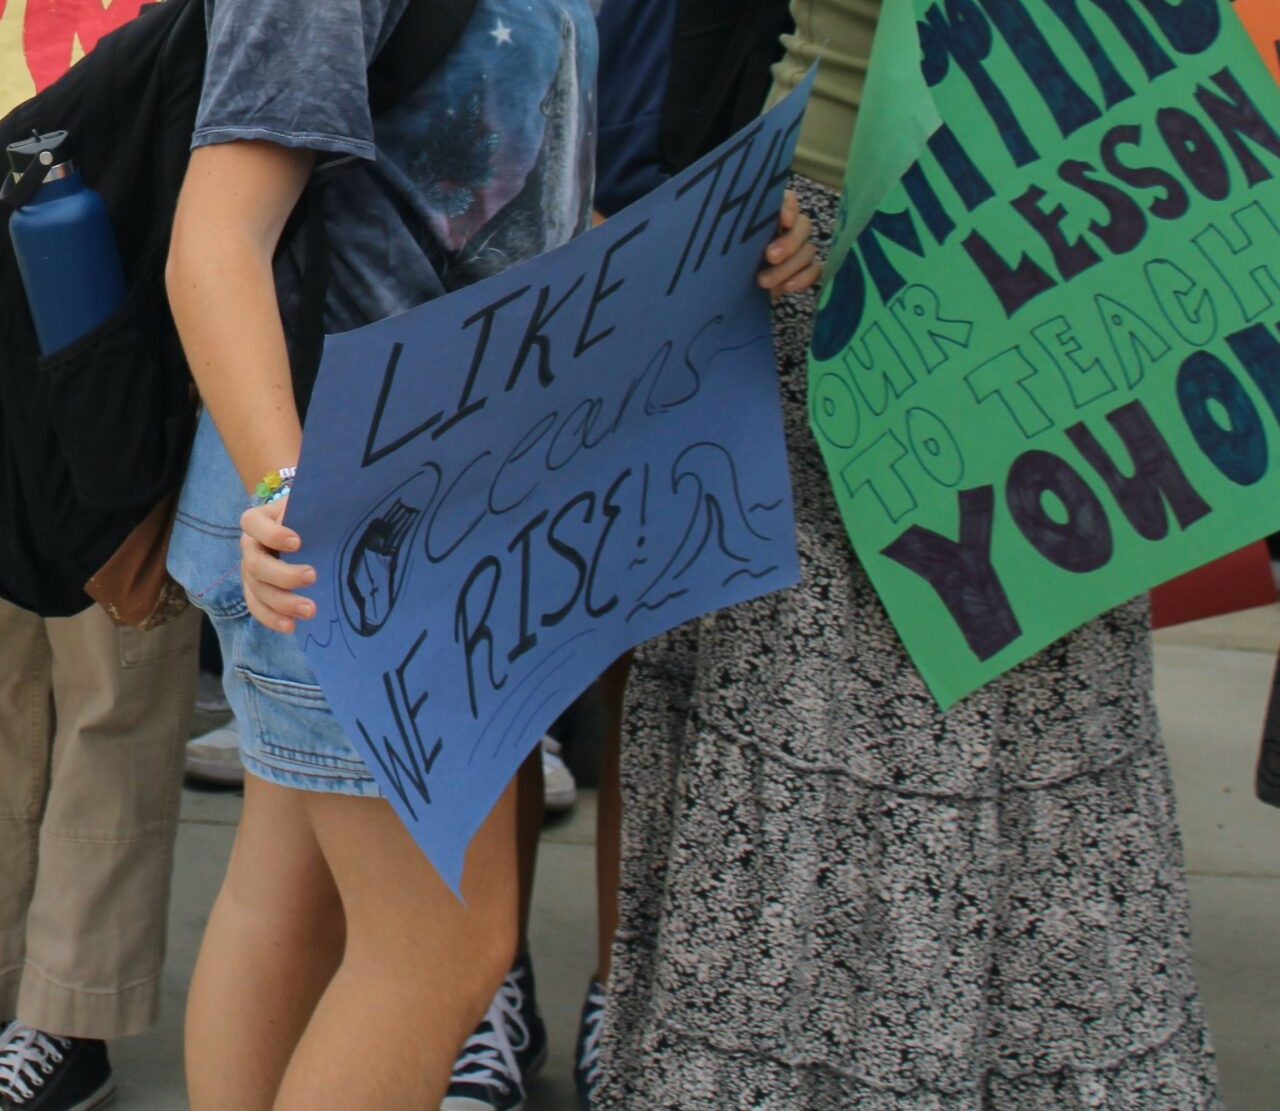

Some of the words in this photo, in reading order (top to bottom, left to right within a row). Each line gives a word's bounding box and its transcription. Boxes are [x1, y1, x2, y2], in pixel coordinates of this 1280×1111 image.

[360, 219, 652, 468] LIKE
[665, 110, 806, 298] THE
[813, 284, 973, 449] OUR
[961, 67, 1280, 319] LESSON
[842, 407, 965, 524] TO
[963, 201, 1280, 439] TEACH
[356, 629, 444, 822] WE
[453, 464, 651, 720] RISE!
[880, 399, 1213, 662] YOU
